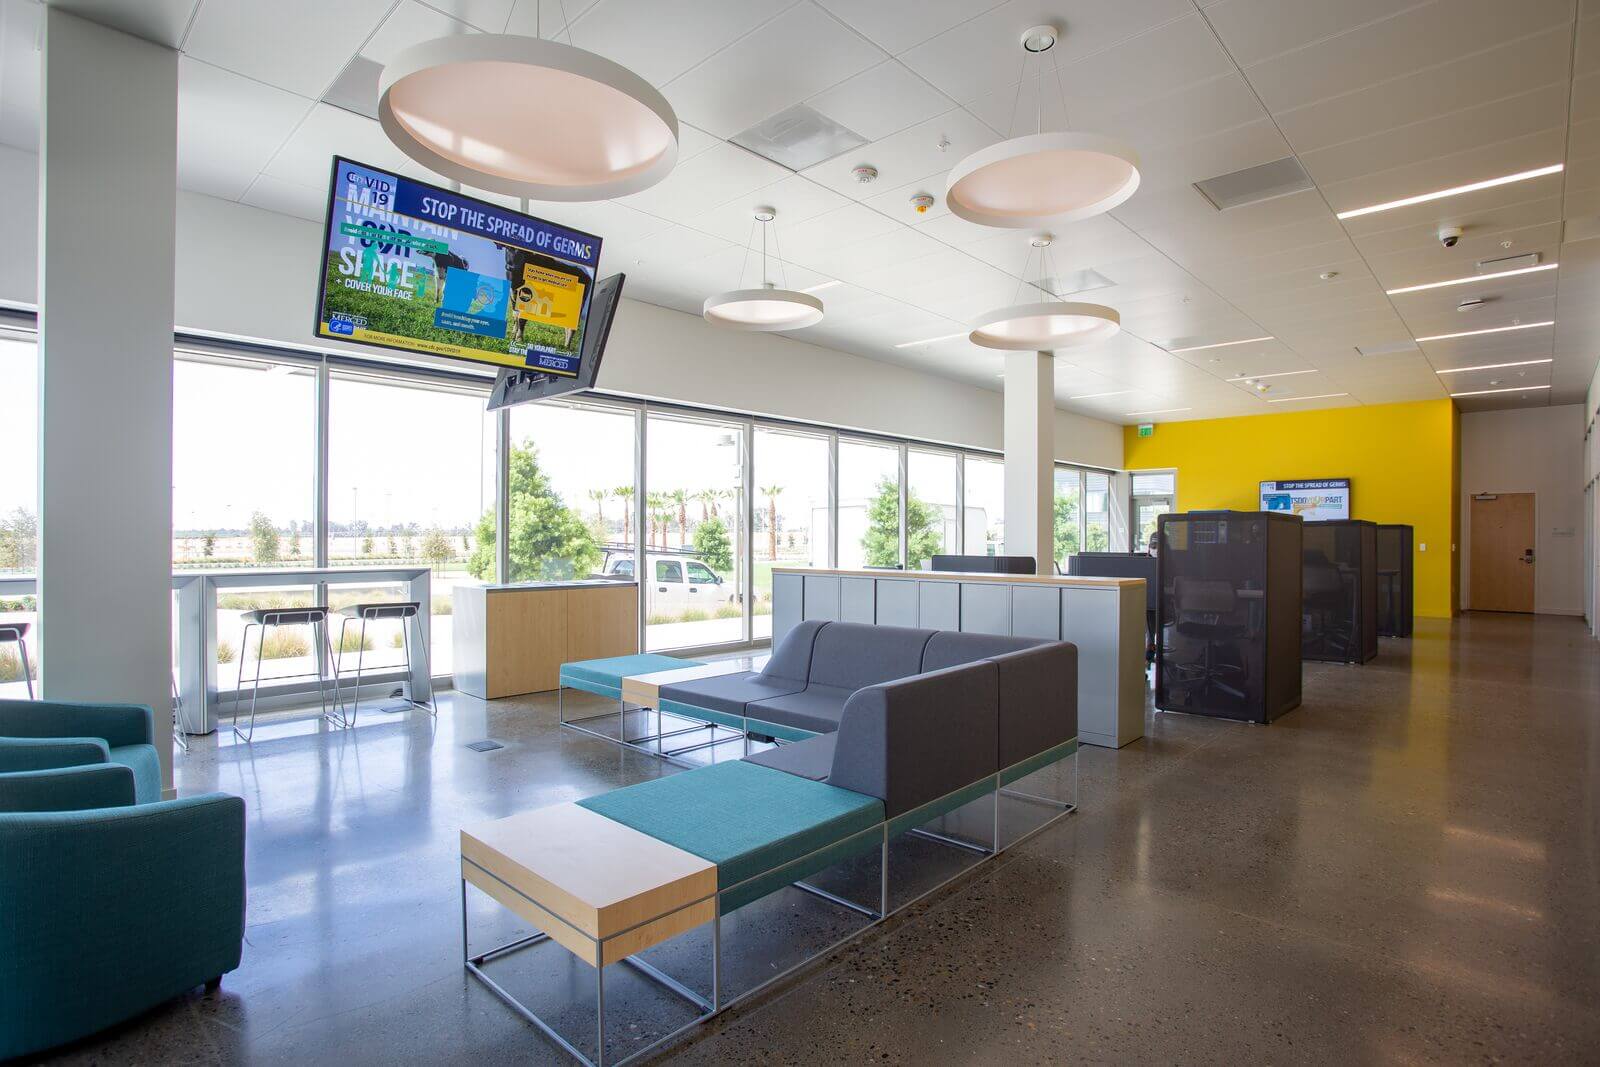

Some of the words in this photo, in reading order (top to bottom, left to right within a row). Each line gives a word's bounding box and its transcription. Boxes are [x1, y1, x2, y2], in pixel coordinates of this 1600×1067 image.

[373, 191, 389, 206] 19
[421, 197, 457, 220] STOP
[460, 207, 485, 230] THE
[486, 216, 535, 243] SPREAD
[536, 231, 553, 248] OF
[553, 236, 592, 260] GERMS
[344, 278, 371, 292] COVER
[372, 283, 392, 297] YOUR
[392, 289, 414, 300] FACE
[539, 357, 568, 369] MERCED
